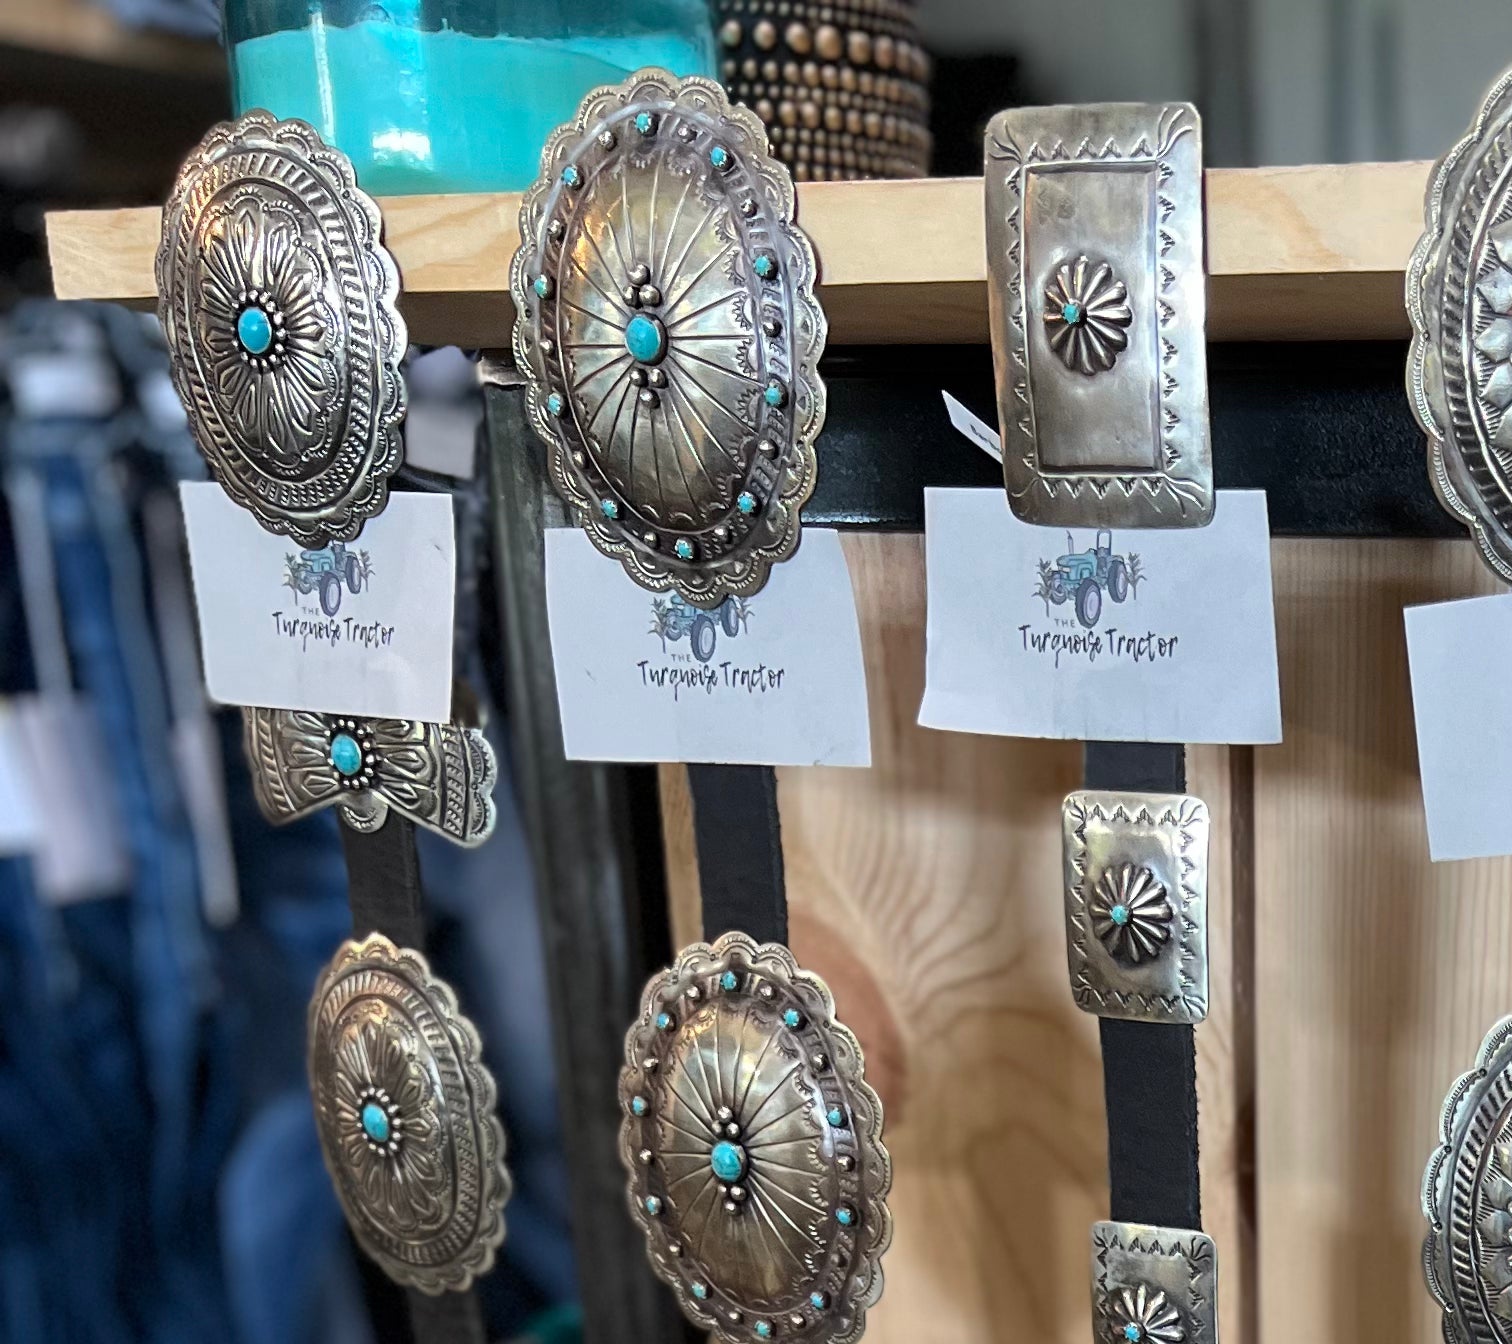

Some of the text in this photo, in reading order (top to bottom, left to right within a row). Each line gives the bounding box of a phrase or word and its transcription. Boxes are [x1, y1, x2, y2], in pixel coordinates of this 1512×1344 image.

[1053, 618, 1076, 628] THE
[670, 653, 692, 663] THE
[1018, 624, 1178, 669] Turquoise Tractor
[636, 660, 785, 702] Turquoise Tractor
